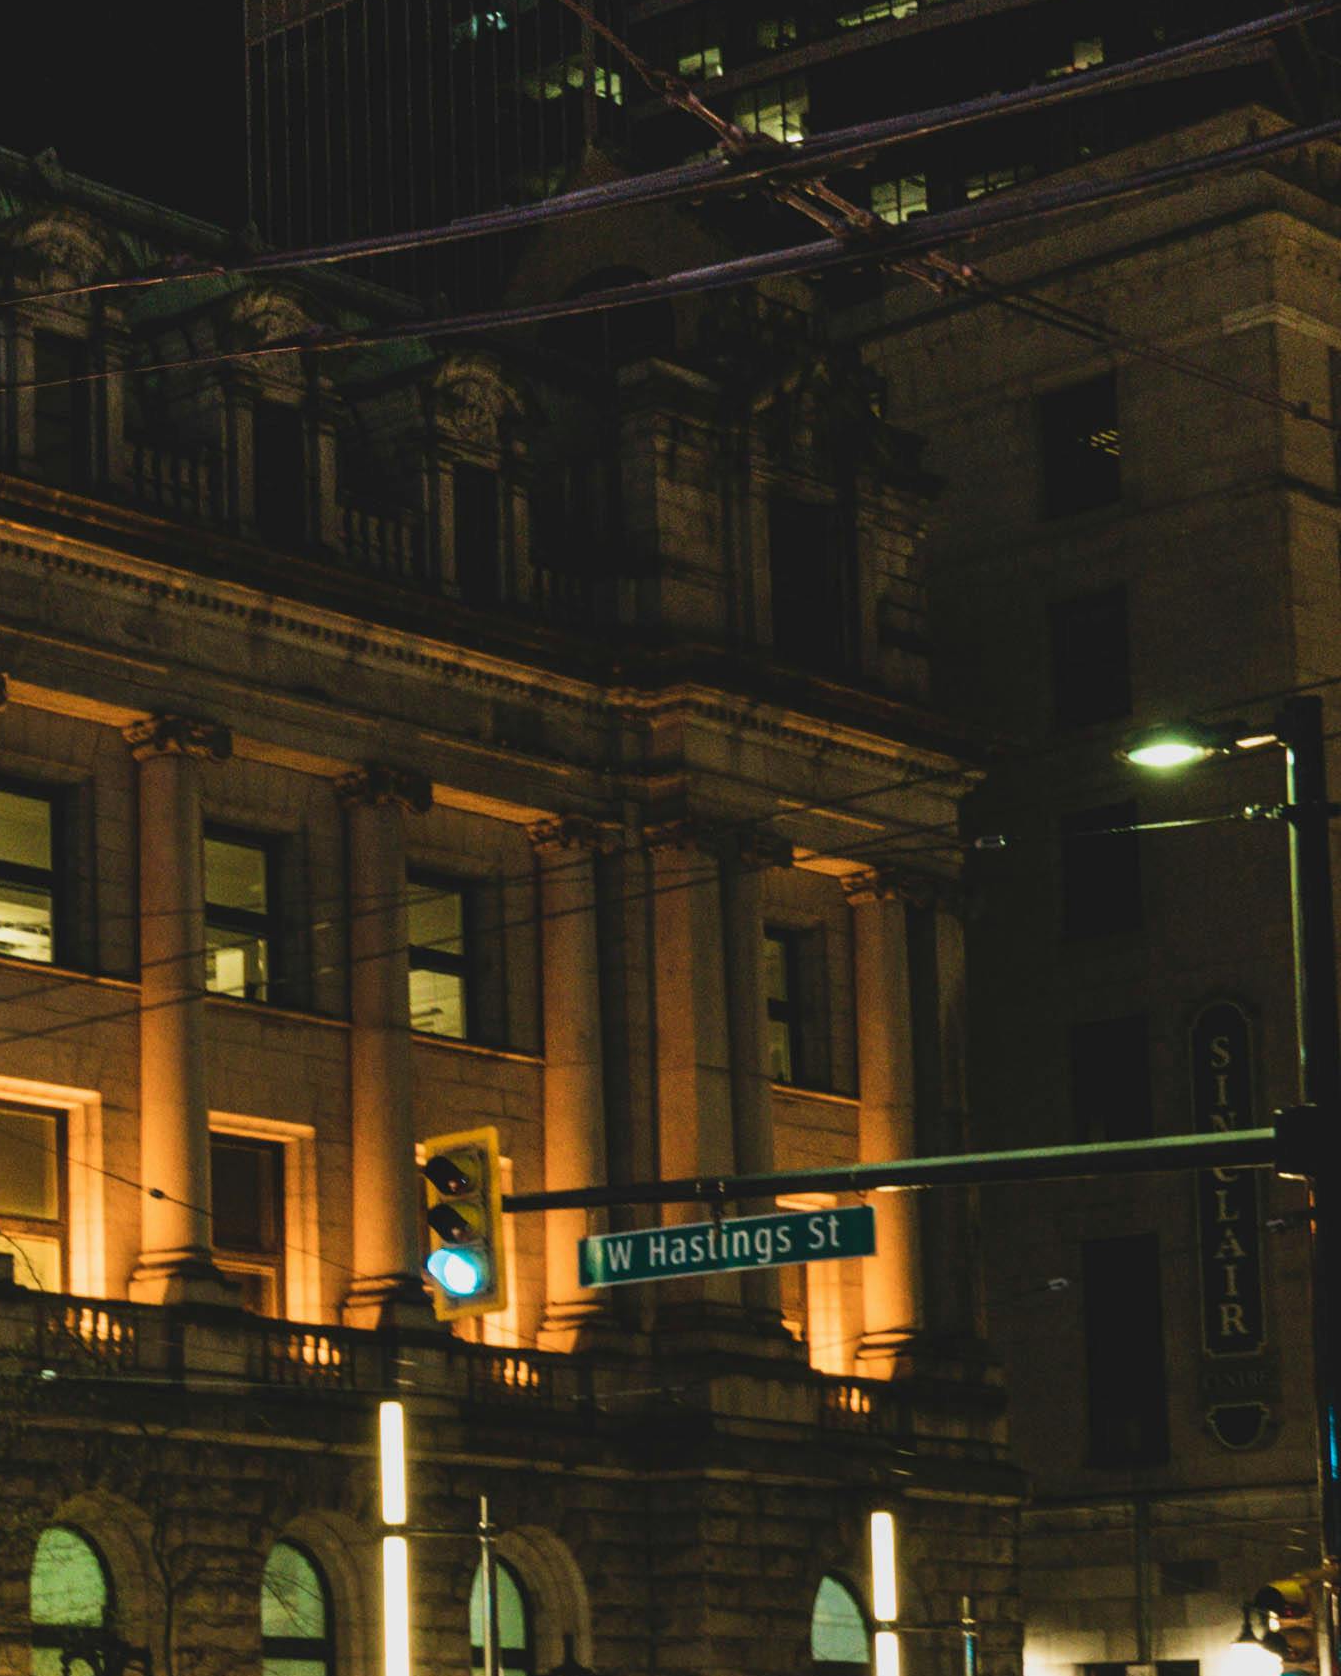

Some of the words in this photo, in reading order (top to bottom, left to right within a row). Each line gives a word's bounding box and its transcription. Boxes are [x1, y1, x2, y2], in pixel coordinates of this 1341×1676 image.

[607, 1239, 633, 1272] W
[649, 1224, 792, 1264] Hastings
[808, 1214, 841, 1250] St
